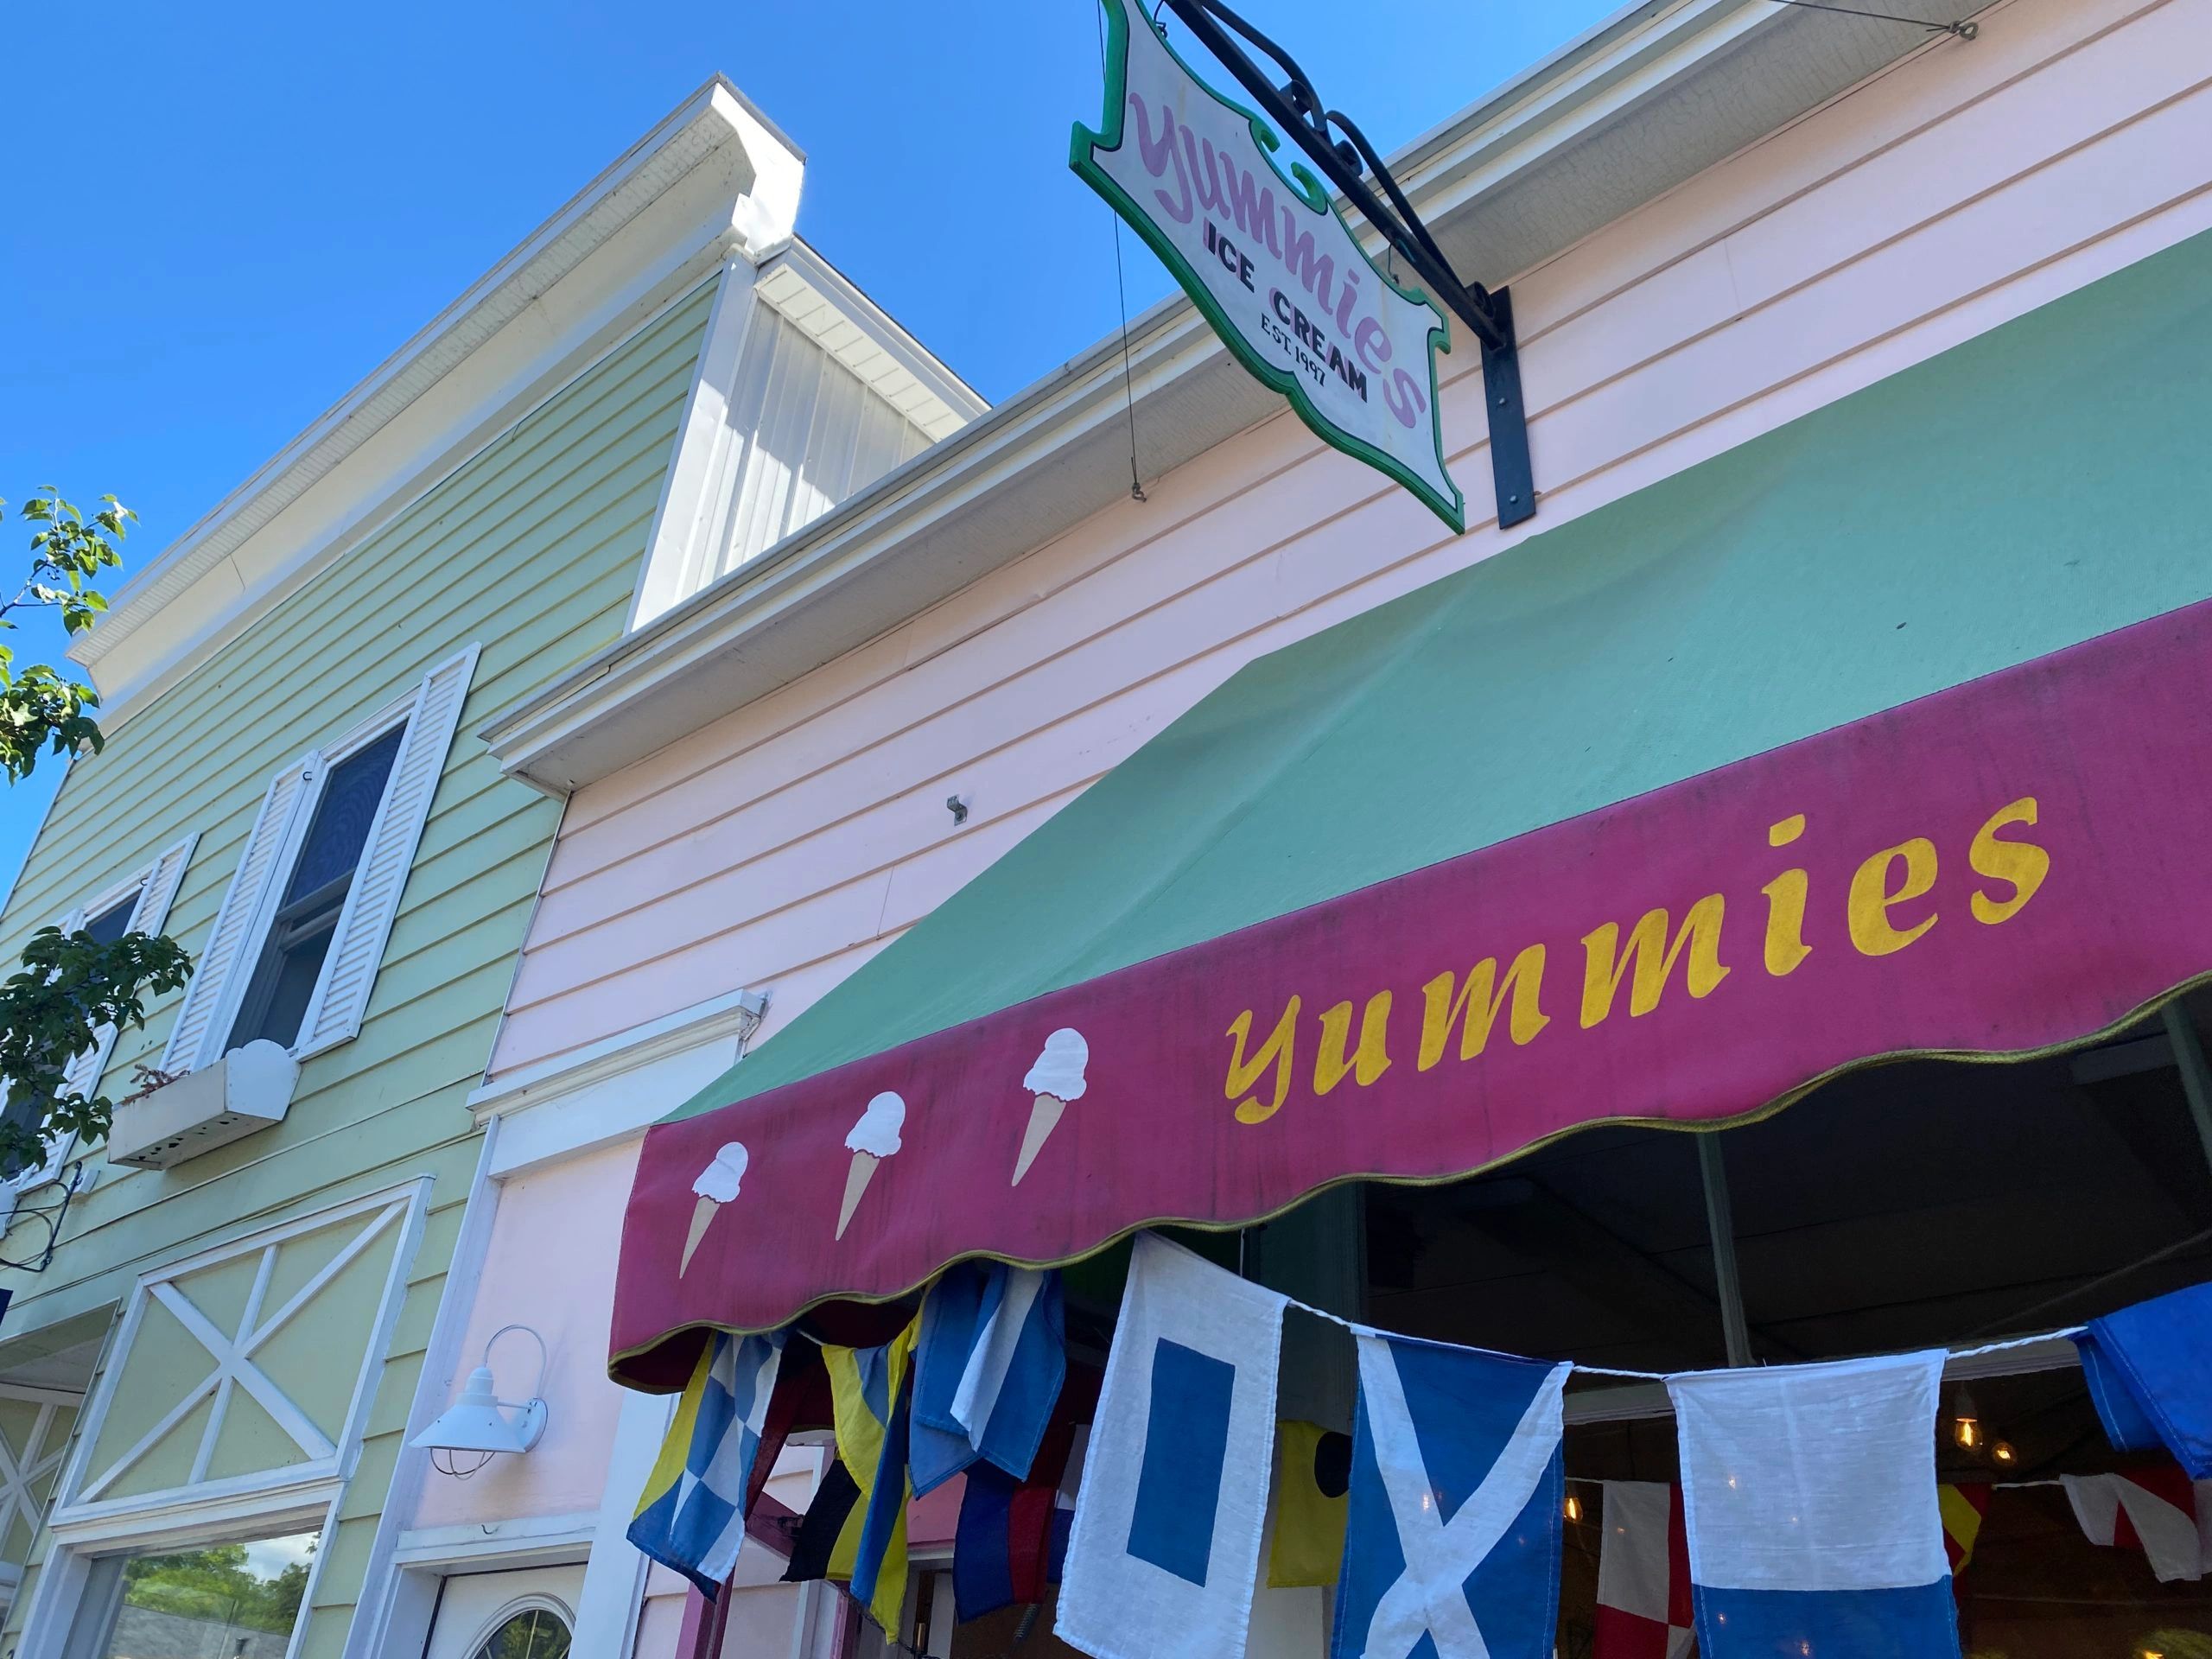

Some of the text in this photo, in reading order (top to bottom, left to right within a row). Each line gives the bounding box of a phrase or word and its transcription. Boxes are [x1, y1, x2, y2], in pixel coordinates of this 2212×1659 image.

[1128, 92, 1427, 429] yummies
[1203, 219, 1368, 403] ICE CREAM
[1295, 350, 1326, 388] 1997
[1224, 797, 2050, 1124] yummies
